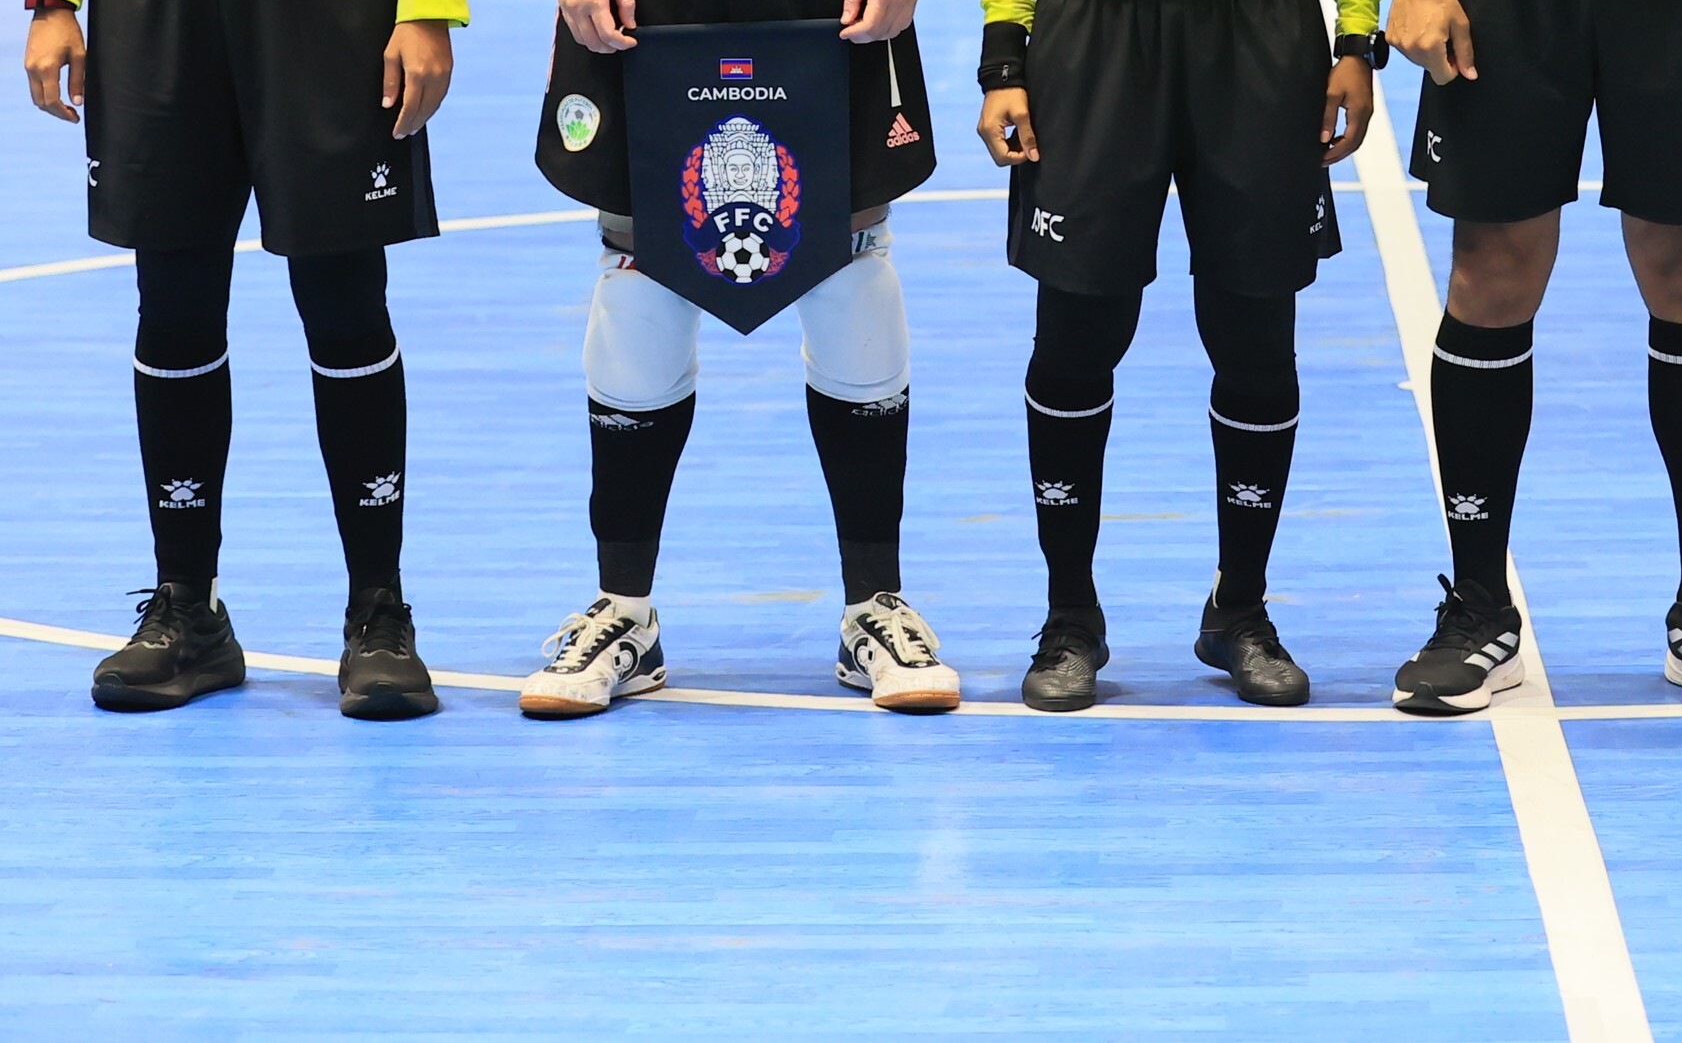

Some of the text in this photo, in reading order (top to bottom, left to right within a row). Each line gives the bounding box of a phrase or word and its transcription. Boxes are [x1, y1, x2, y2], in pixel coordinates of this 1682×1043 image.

[687, 87, 787, 101] CAMBODIA
[886, 130, 921, 148] adidas
[365, 186, 398, 201] KELME
[713, 208, 774, 233] FFC
[1031, 207, 1065, 242] AFC
[1309, 221, 1323, 235] KEL
[159, 498, 206, 509] KELME
[359, 490, 400, 507] KELME
[1036, 496, 1079, 506] KELME
[1226, 496, 1272, 509] KELME
[1448, 511, 1489, 521] KELME
